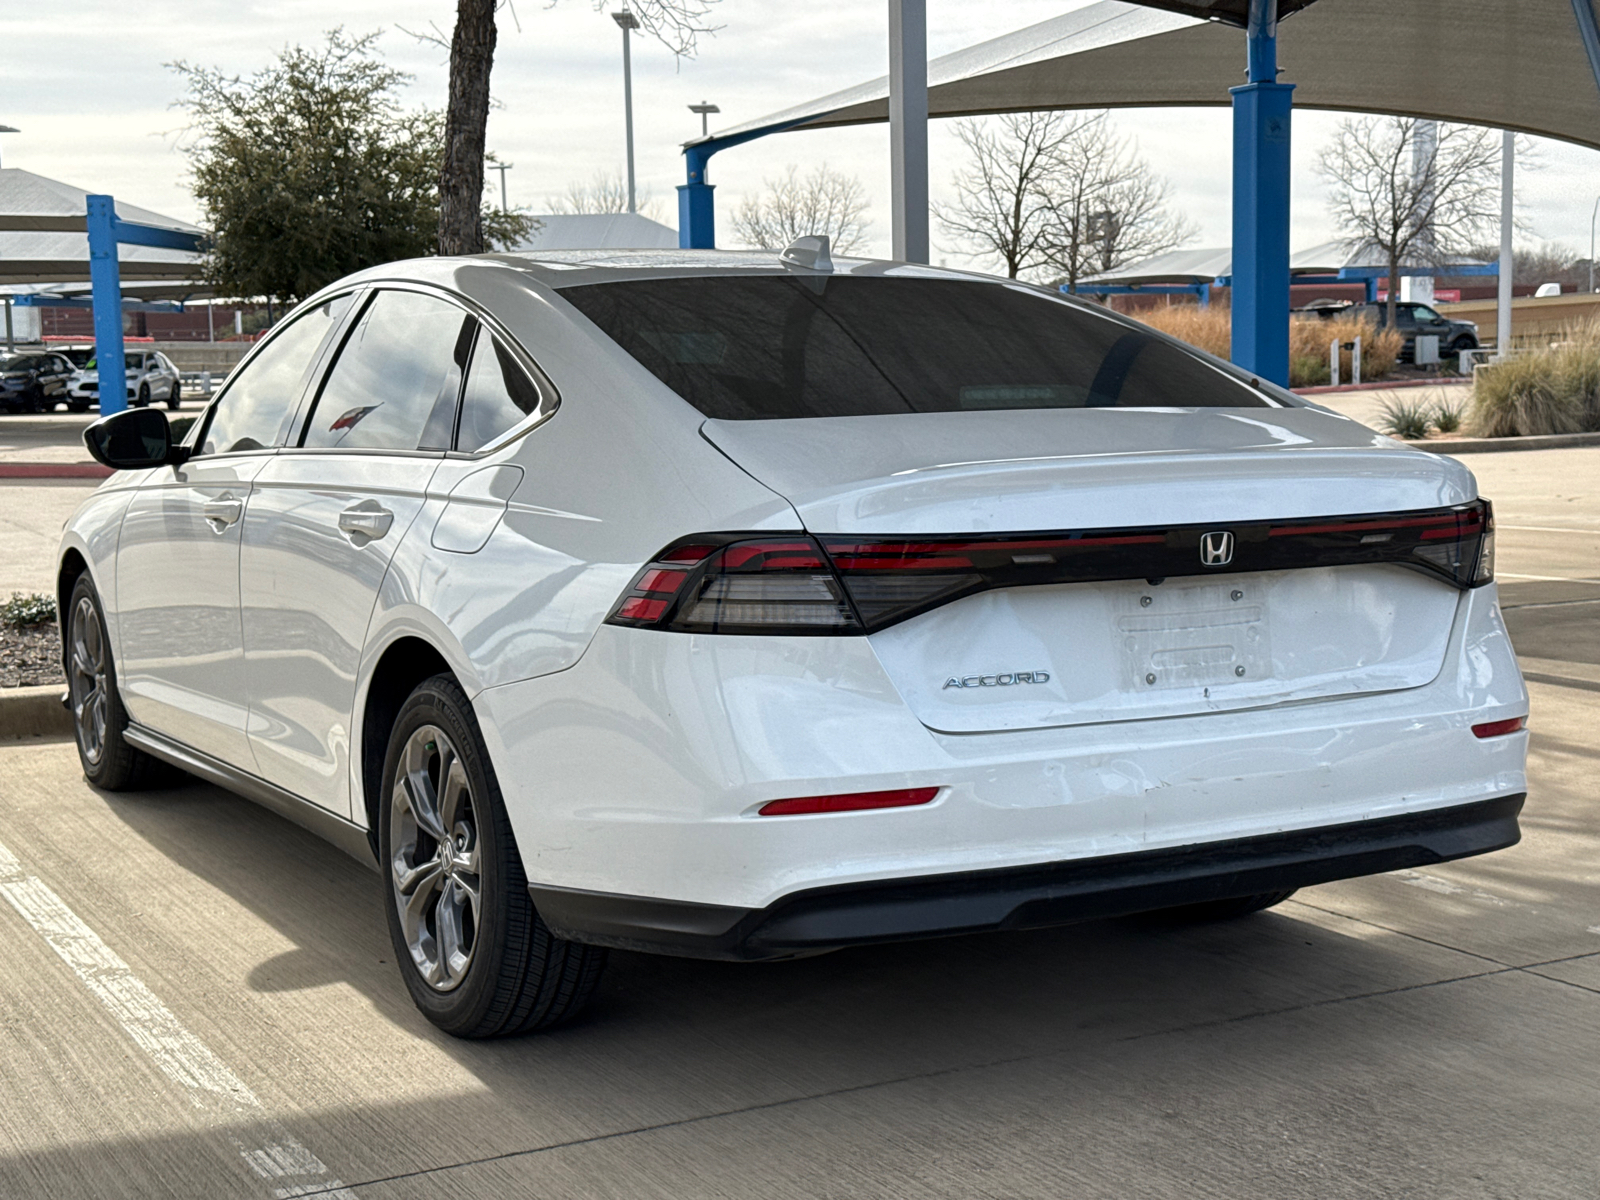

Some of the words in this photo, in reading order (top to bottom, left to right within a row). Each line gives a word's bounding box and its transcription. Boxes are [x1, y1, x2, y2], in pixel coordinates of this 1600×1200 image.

[1205, 532, 1229, 565] H
[942, 670, 1050, 690] ACCORD
[442, 704, 473, 758] MICHELIN
